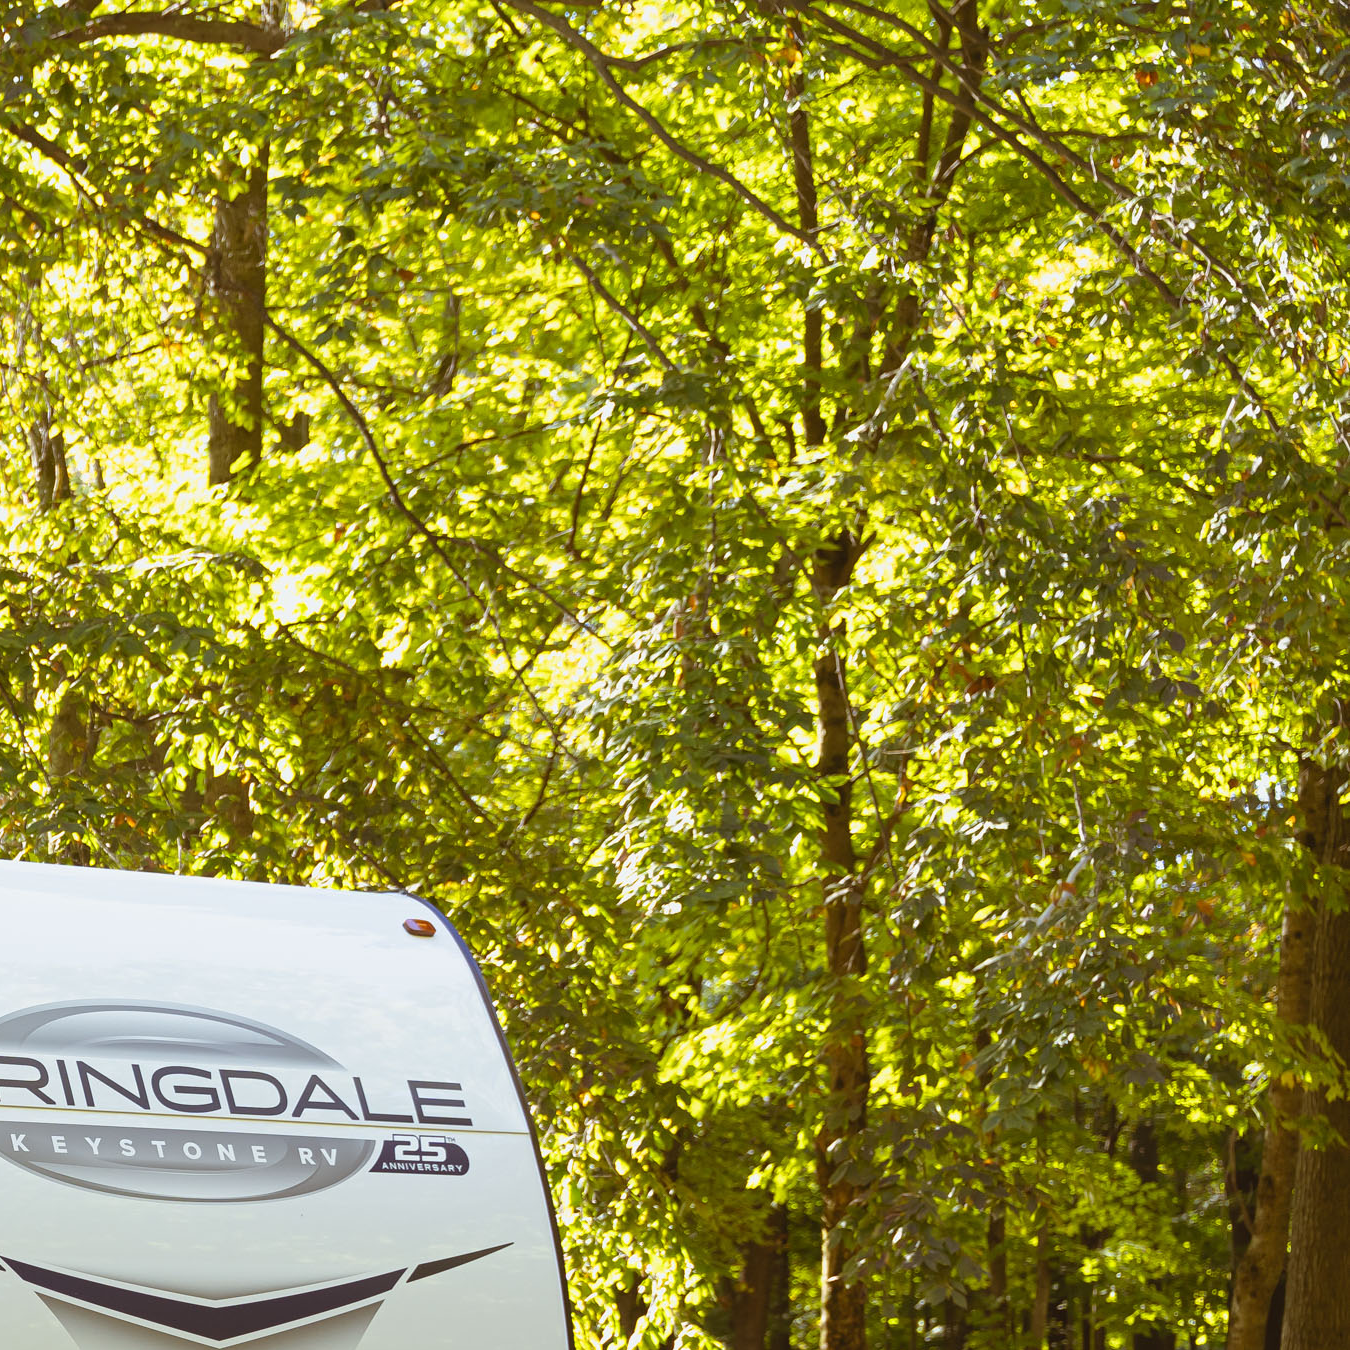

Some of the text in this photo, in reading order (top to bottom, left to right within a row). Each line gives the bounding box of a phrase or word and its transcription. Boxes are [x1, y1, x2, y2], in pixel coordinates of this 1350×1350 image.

[10, 1133, 338, 1168] KEYSTONE RV
[381, 1161, 463, 1173] ANNIVERSARY
